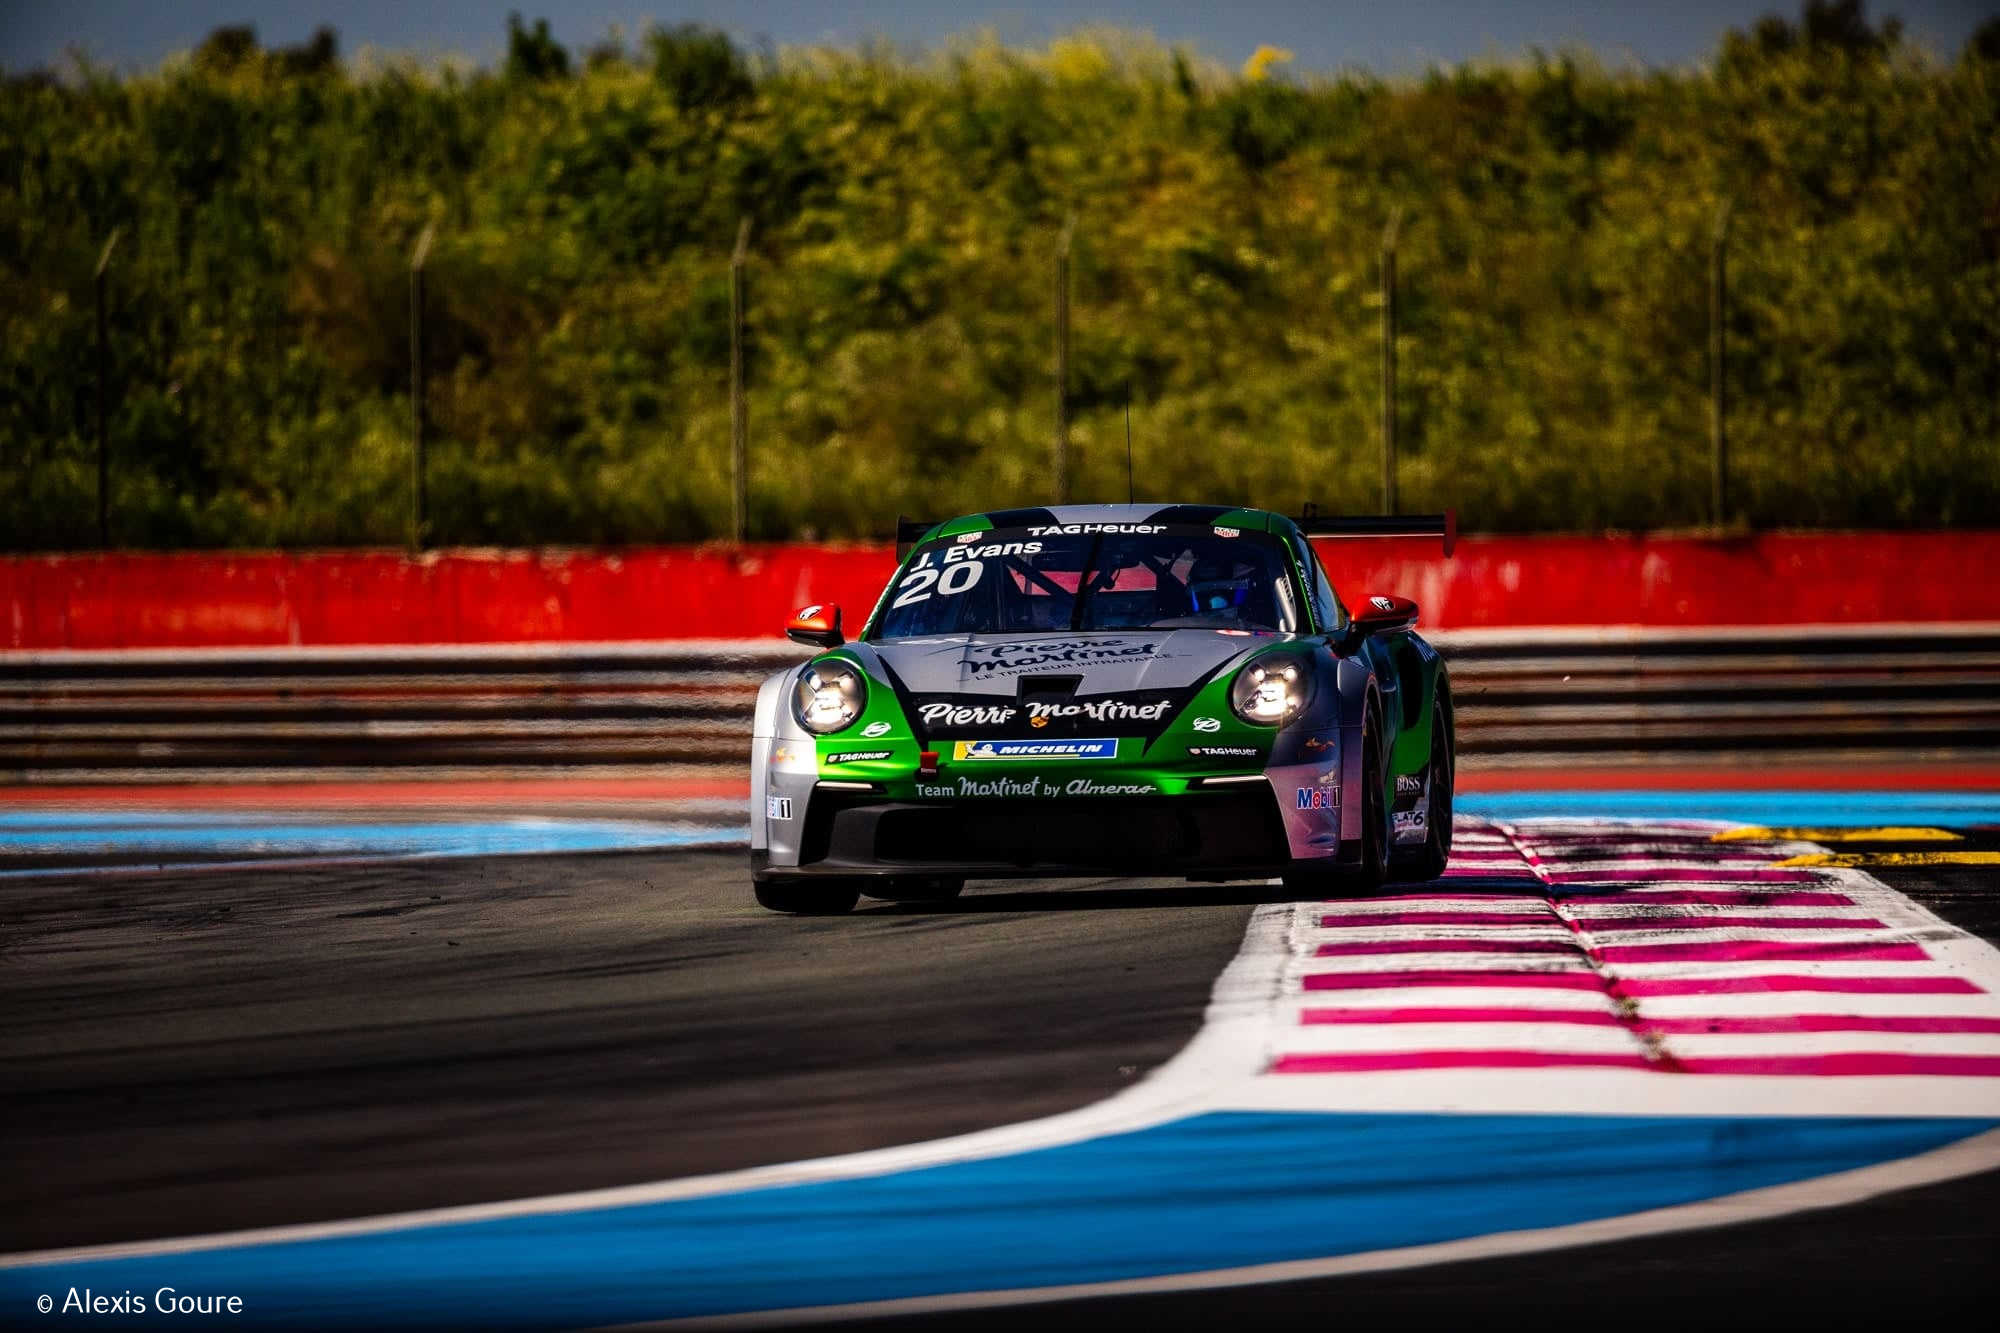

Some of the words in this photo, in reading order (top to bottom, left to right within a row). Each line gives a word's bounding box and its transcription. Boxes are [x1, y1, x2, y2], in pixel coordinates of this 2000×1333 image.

[910, 553, 934, 573] J.
[943, 541, 1043, 564] Evans
[892, 560, 984, 609] 20
[975, 672, 994, 681] LE
[998, 662, 1073, 679] TRAITEUR
[999, 743, 1104, 755] MICHELIN
[915, 783, 955, 796] Team
[1043, 783, 1061, 797] by
[1396, 776, 1421, 792] BOSS
